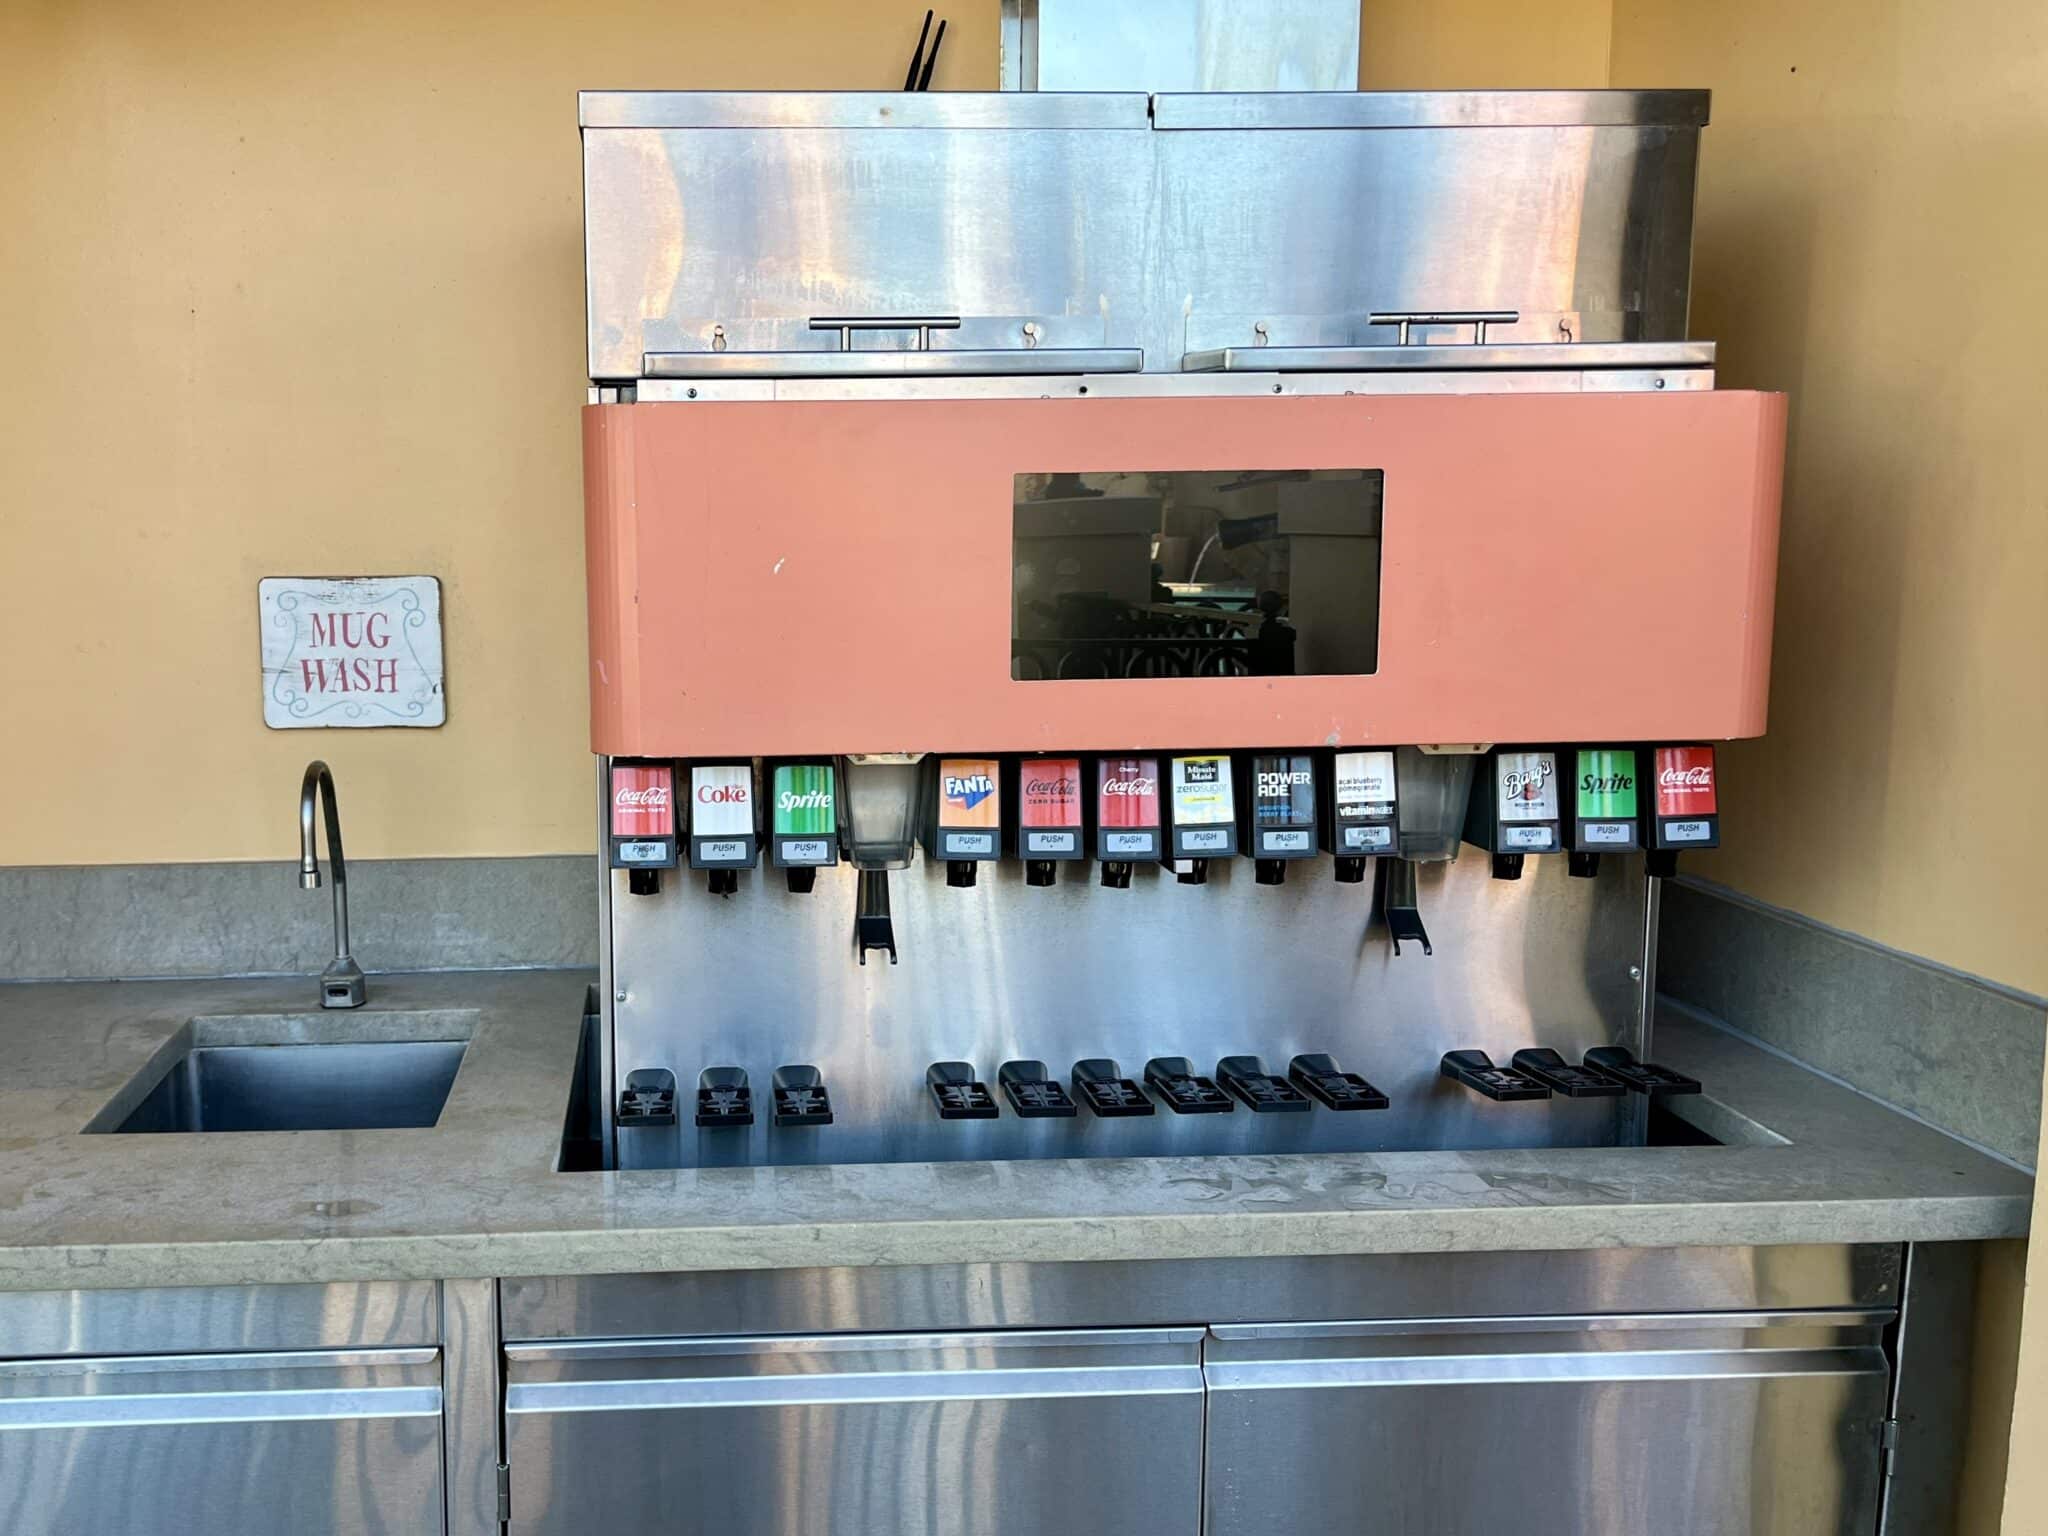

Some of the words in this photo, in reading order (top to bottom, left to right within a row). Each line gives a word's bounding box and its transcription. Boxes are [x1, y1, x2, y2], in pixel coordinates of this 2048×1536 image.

[308, 612, 391, 648] MUG
[301, 658, 398, 693] WASH
[1187, 766, 1216, 774] Minute
[1192, 773, 1213, 781] Maid
[1258, 772, 1311, 785] POWER
[1504, 760, 1553, 800] Barq's
[1660, 767, 1712, 786] Coca-Cola
[944, 775, 994, 795] FANTA
[1026, 779, 1074, 796] Coca-Cola
[1103, 778, 1154, 796] Coca-Cola
[1580, 773, 1633, 795] Sprite
[615, 787, 669, 805] Coca-Cola
[698, 785, 747, 803] Coke
[1258, 785, 1290, 797] ADE
[778, 790, 832, 812] Sprite
[1519, 830, 1541, 838] PUSH
[1597, 826, 1619, 834] PUSH
[1677, 824, 1700, 832] PUSH
[959, 836, 981, 844] PUSH
[1040, 835, 1064, 843] PUSH
[1119, 835, 1142, 844] PUSH
[1194, 833, 1217, 841] PUSH
[1275, 833, 1298, 841] PUSH
[794, 843, 817, 851] PUSH
